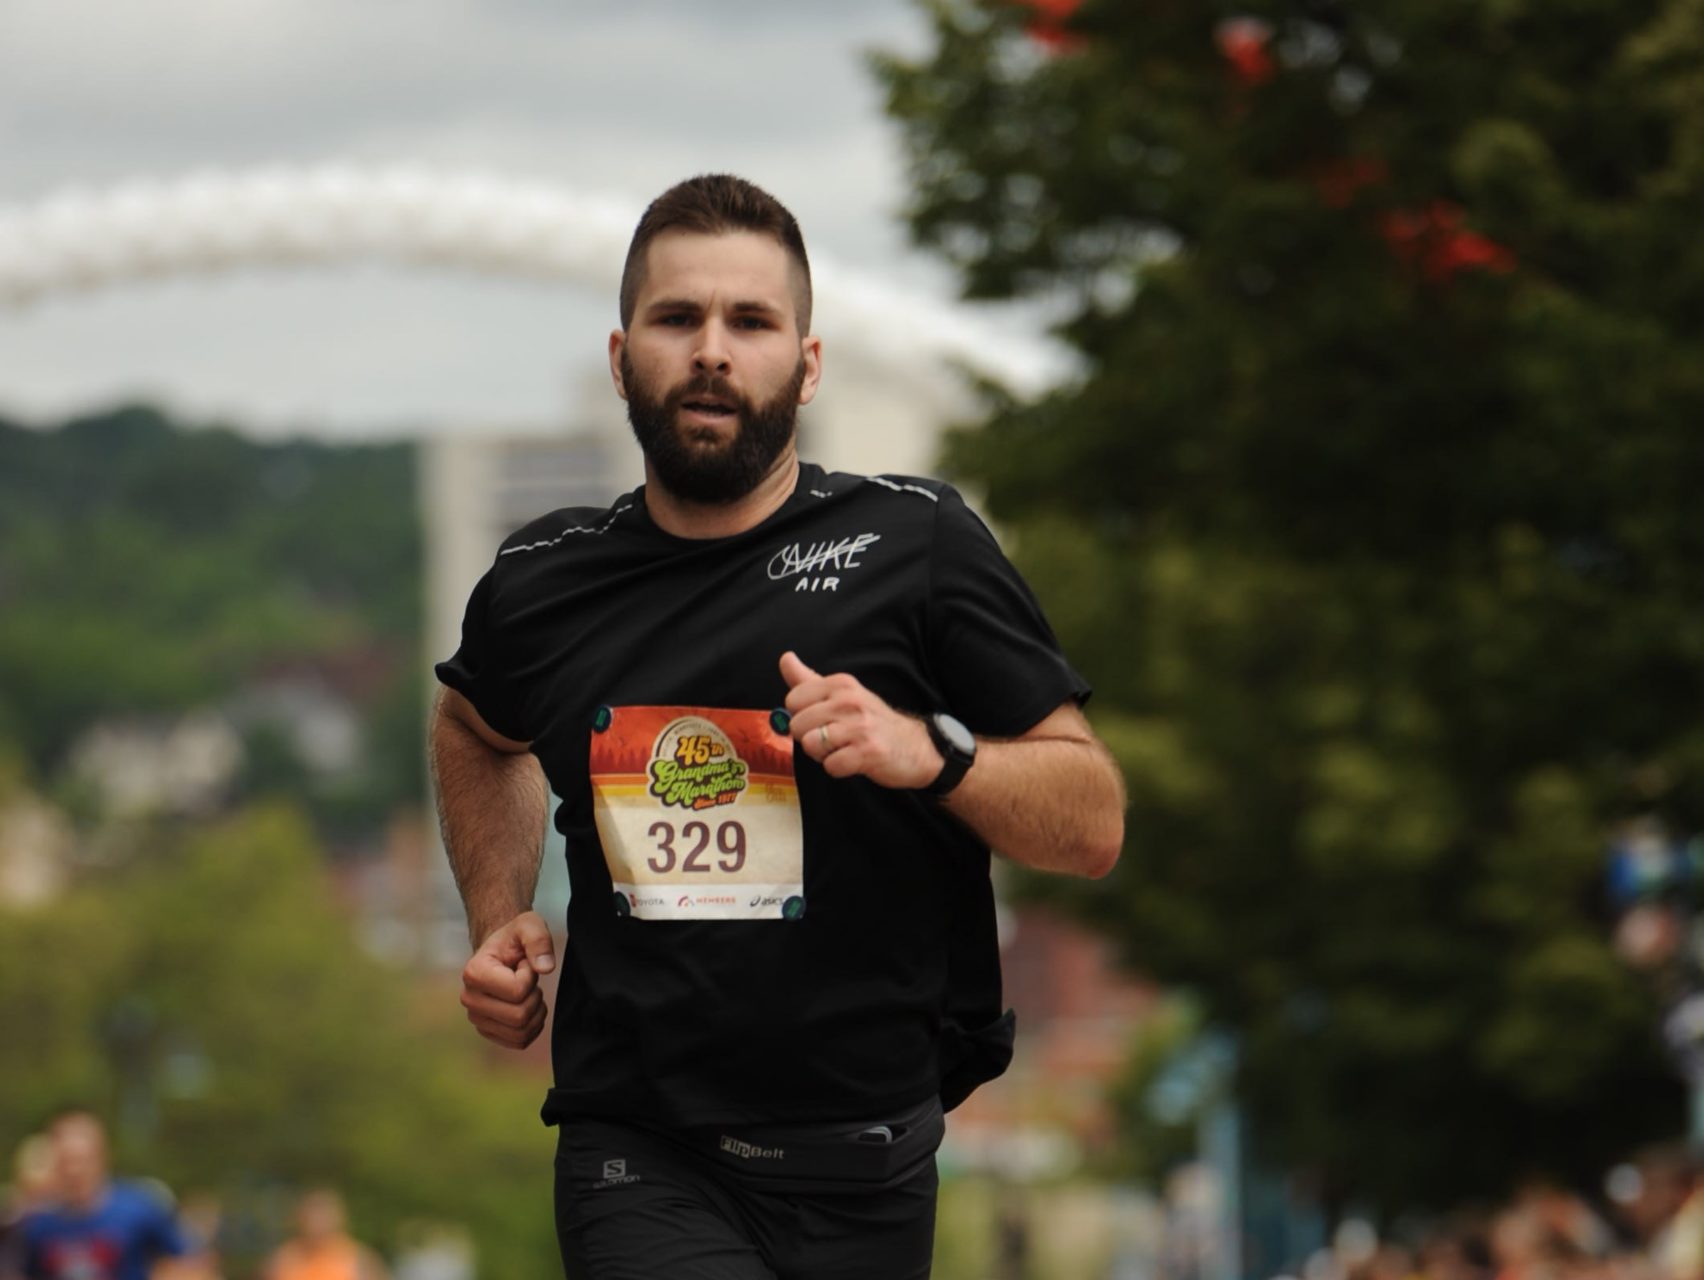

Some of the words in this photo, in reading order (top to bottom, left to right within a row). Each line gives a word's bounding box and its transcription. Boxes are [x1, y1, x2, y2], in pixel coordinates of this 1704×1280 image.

[778, 533, 877, 577] NIKE
[795, 577, 840, 592] AIR
[651, 758, 745, 796] Grandma's
[662, 772, 745, 809] Marathon
[647, 820, 747, 874] 329
[636, 898, 664, 906] OYOTA
